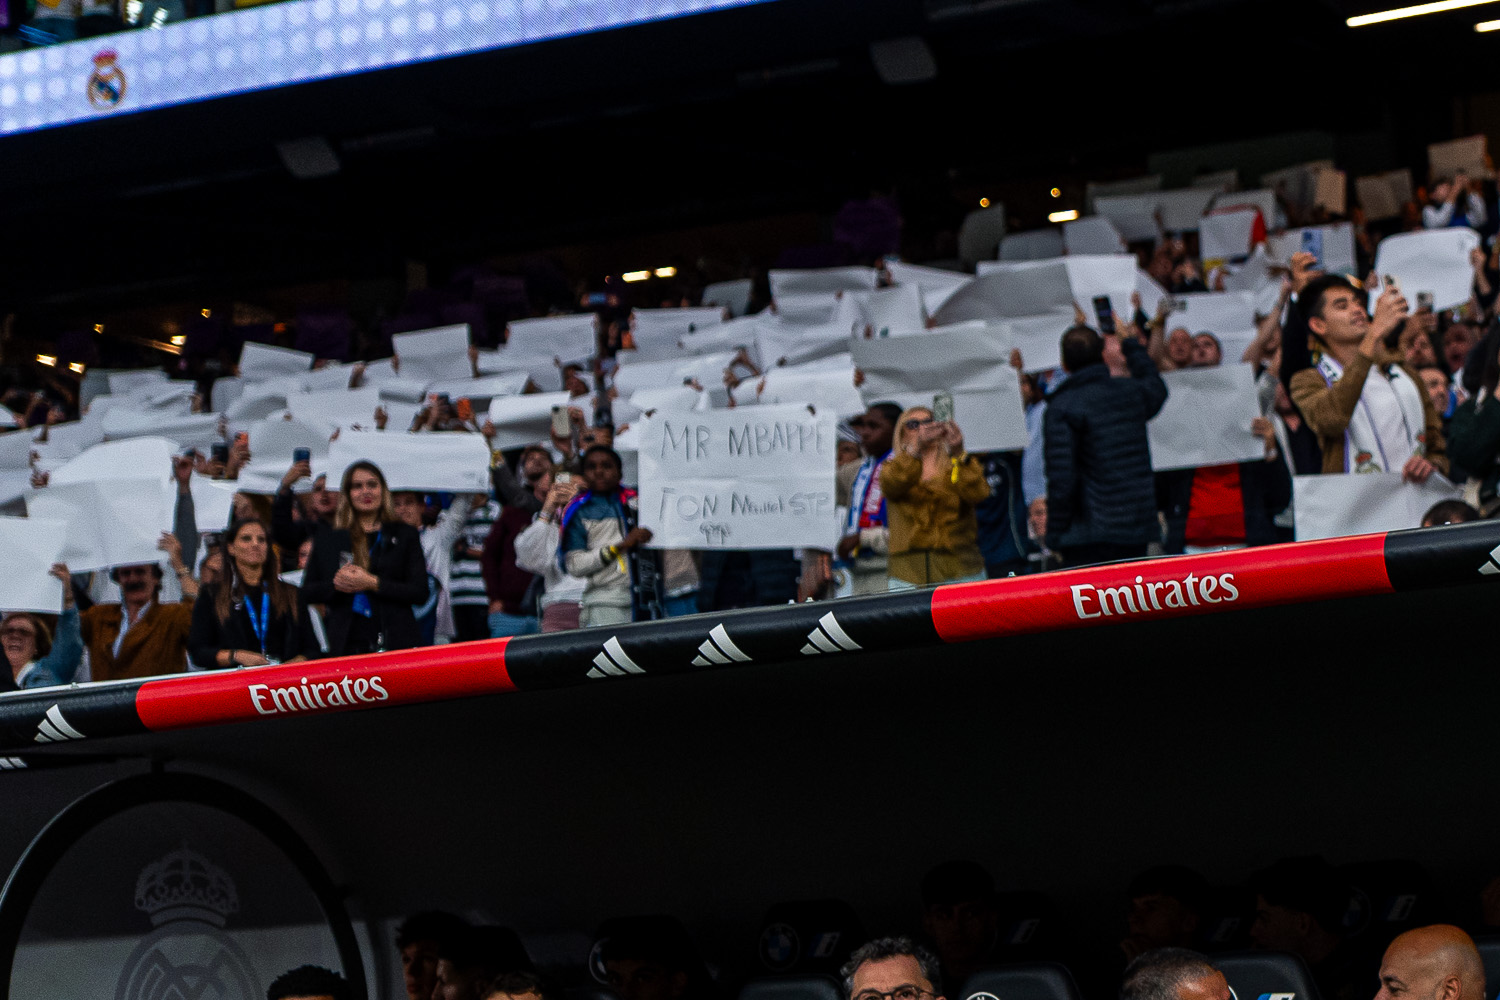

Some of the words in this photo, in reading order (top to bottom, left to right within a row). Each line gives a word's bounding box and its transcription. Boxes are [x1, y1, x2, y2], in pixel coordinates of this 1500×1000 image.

[660, 420, 711, 462] MR
[659, 487, 718, 523] TON
[1069, 572, 1239, 619] Emirates
[248, 674, 389, 715] Emirates
